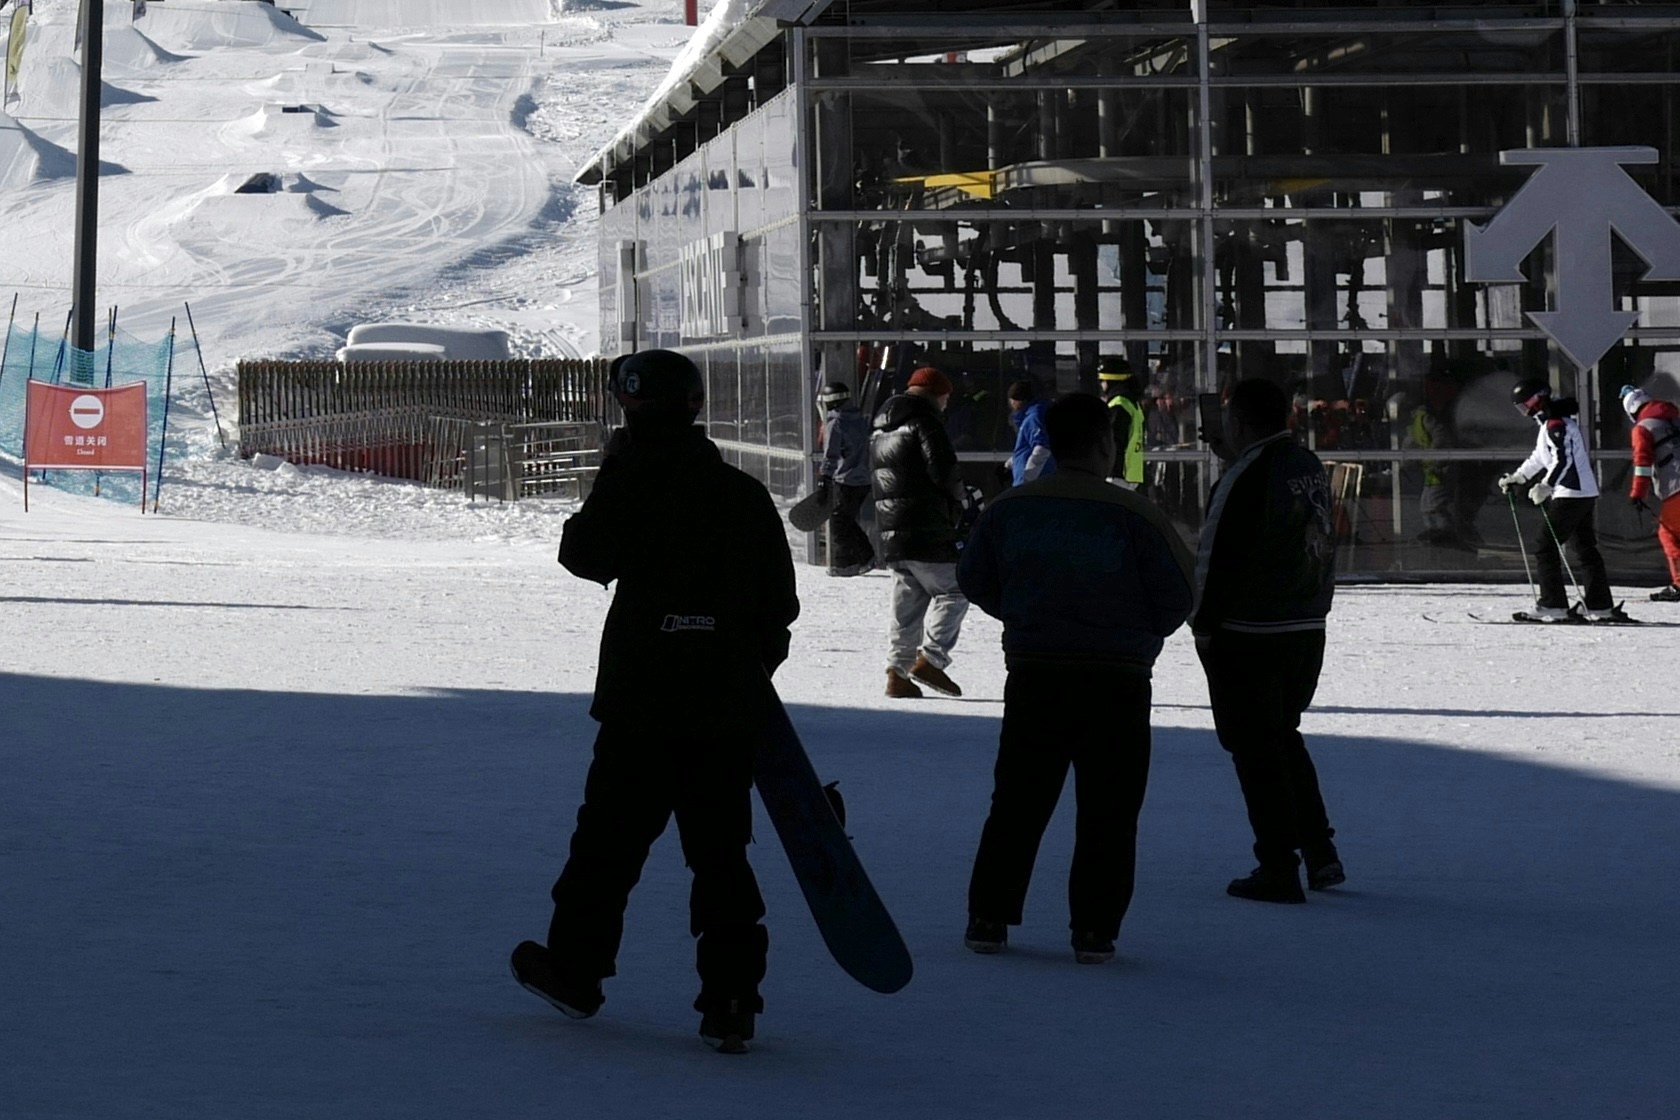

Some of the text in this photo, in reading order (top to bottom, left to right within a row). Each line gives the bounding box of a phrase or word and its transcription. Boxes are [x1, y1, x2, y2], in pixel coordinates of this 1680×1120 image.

[63, 435, 108, 447] 雪道关闭
[679, 615, 716, 625] NITRO
